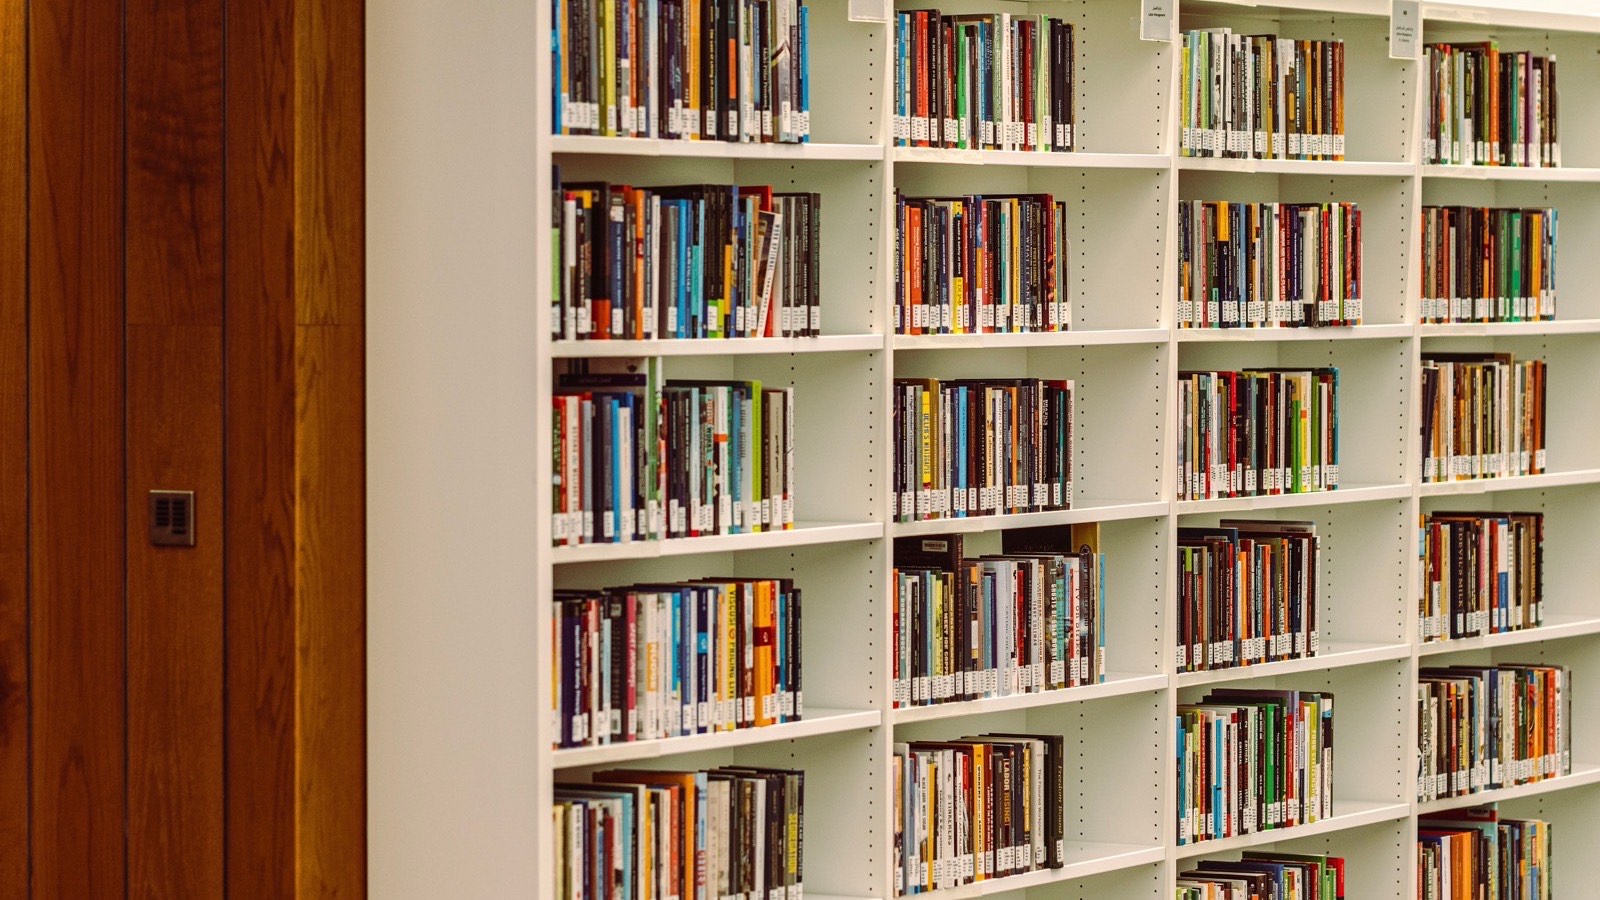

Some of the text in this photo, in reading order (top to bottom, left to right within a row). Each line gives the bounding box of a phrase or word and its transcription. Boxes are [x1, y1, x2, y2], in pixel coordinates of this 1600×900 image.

[896, 241, 900, 250] OF
[768, 243, 777, 271] OPTIONAL
[901, 586, 905, 595] ON
[788, 813, 797, 873] SEGREGATION
